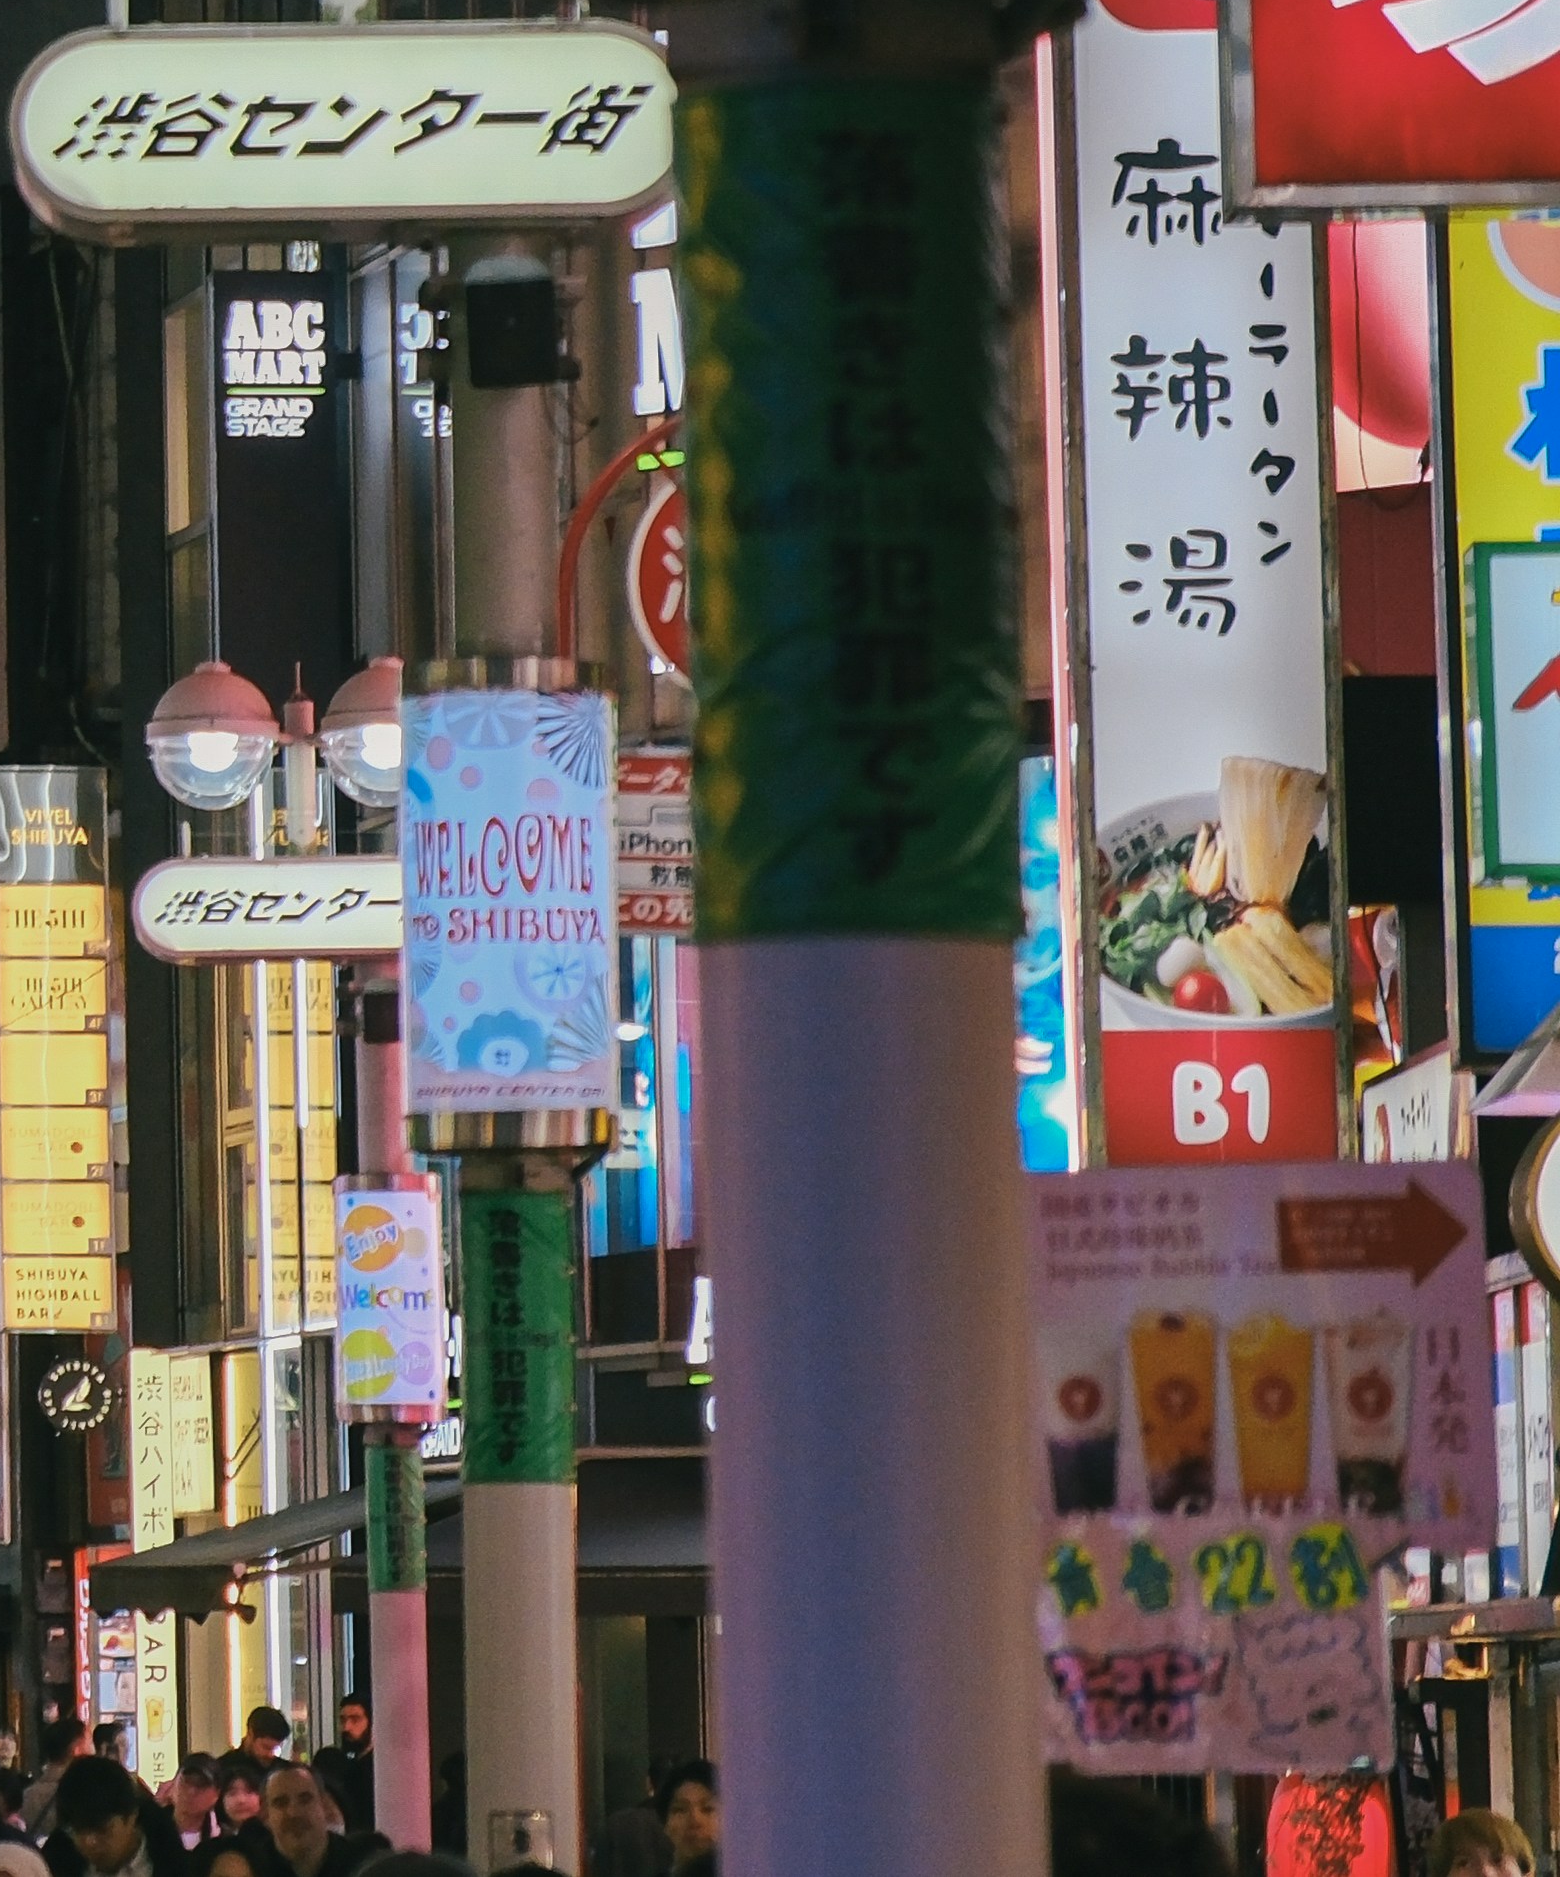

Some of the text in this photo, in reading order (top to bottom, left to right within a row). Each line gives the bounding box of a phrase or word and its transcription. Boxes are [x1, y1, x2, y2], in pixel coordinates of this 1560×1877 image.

[52, 84, 655, 161] 渋谷センター街
[225, 300, 325, 350] ABC
[225, 350, 326, 385] MART
[225, 397, 314, 419] GRAND
[1248, 223, 1297, 566] ーラータン
[225, 419, 306, 438] STAGE
[418, 812, 595, 900] WELCOME
[447, 906, 607, 945] SHIBUYA
[1171, 1060, 1273, 1145] B1
[343, 1221, 400, 1262] Enjoy
[16, 1268, 89, 1282] SHIBUYA
[16, 1289, 102, 1303] HIGHBALL
